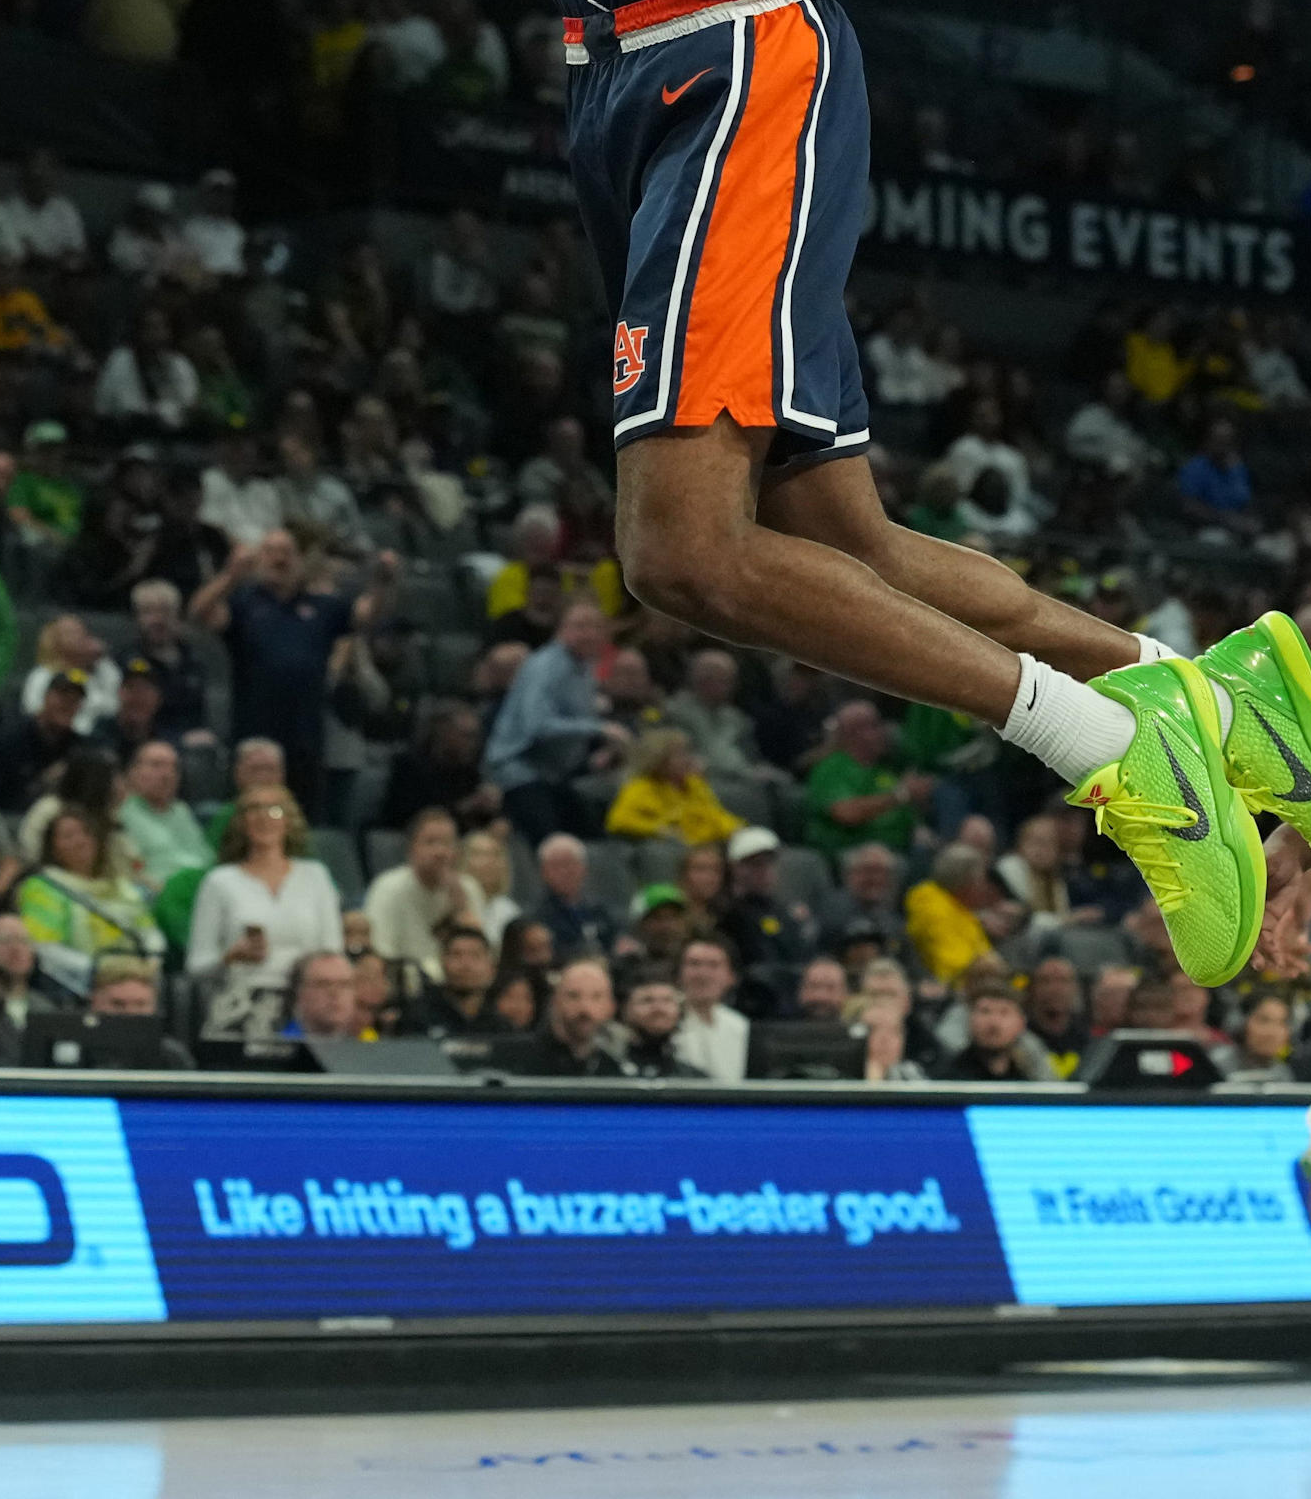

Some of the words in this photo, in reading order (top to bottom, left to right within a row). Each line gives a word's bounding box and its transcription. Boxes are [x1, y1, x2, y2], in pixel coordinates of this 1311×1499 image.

[861, 177, 1051, 262] MING
[1068, 202, 1294, 296] EVENTS
[194, 1178, 307, 1238] Like
[304, 1178, 476, 1251] hitting
[474, 1192, 510, 1237] a
[507, 1177, 829, 1237] buzzer-beater
[834, 1177, 961, 1246] good.
[1154, 1184, 1246, 1224] Good
